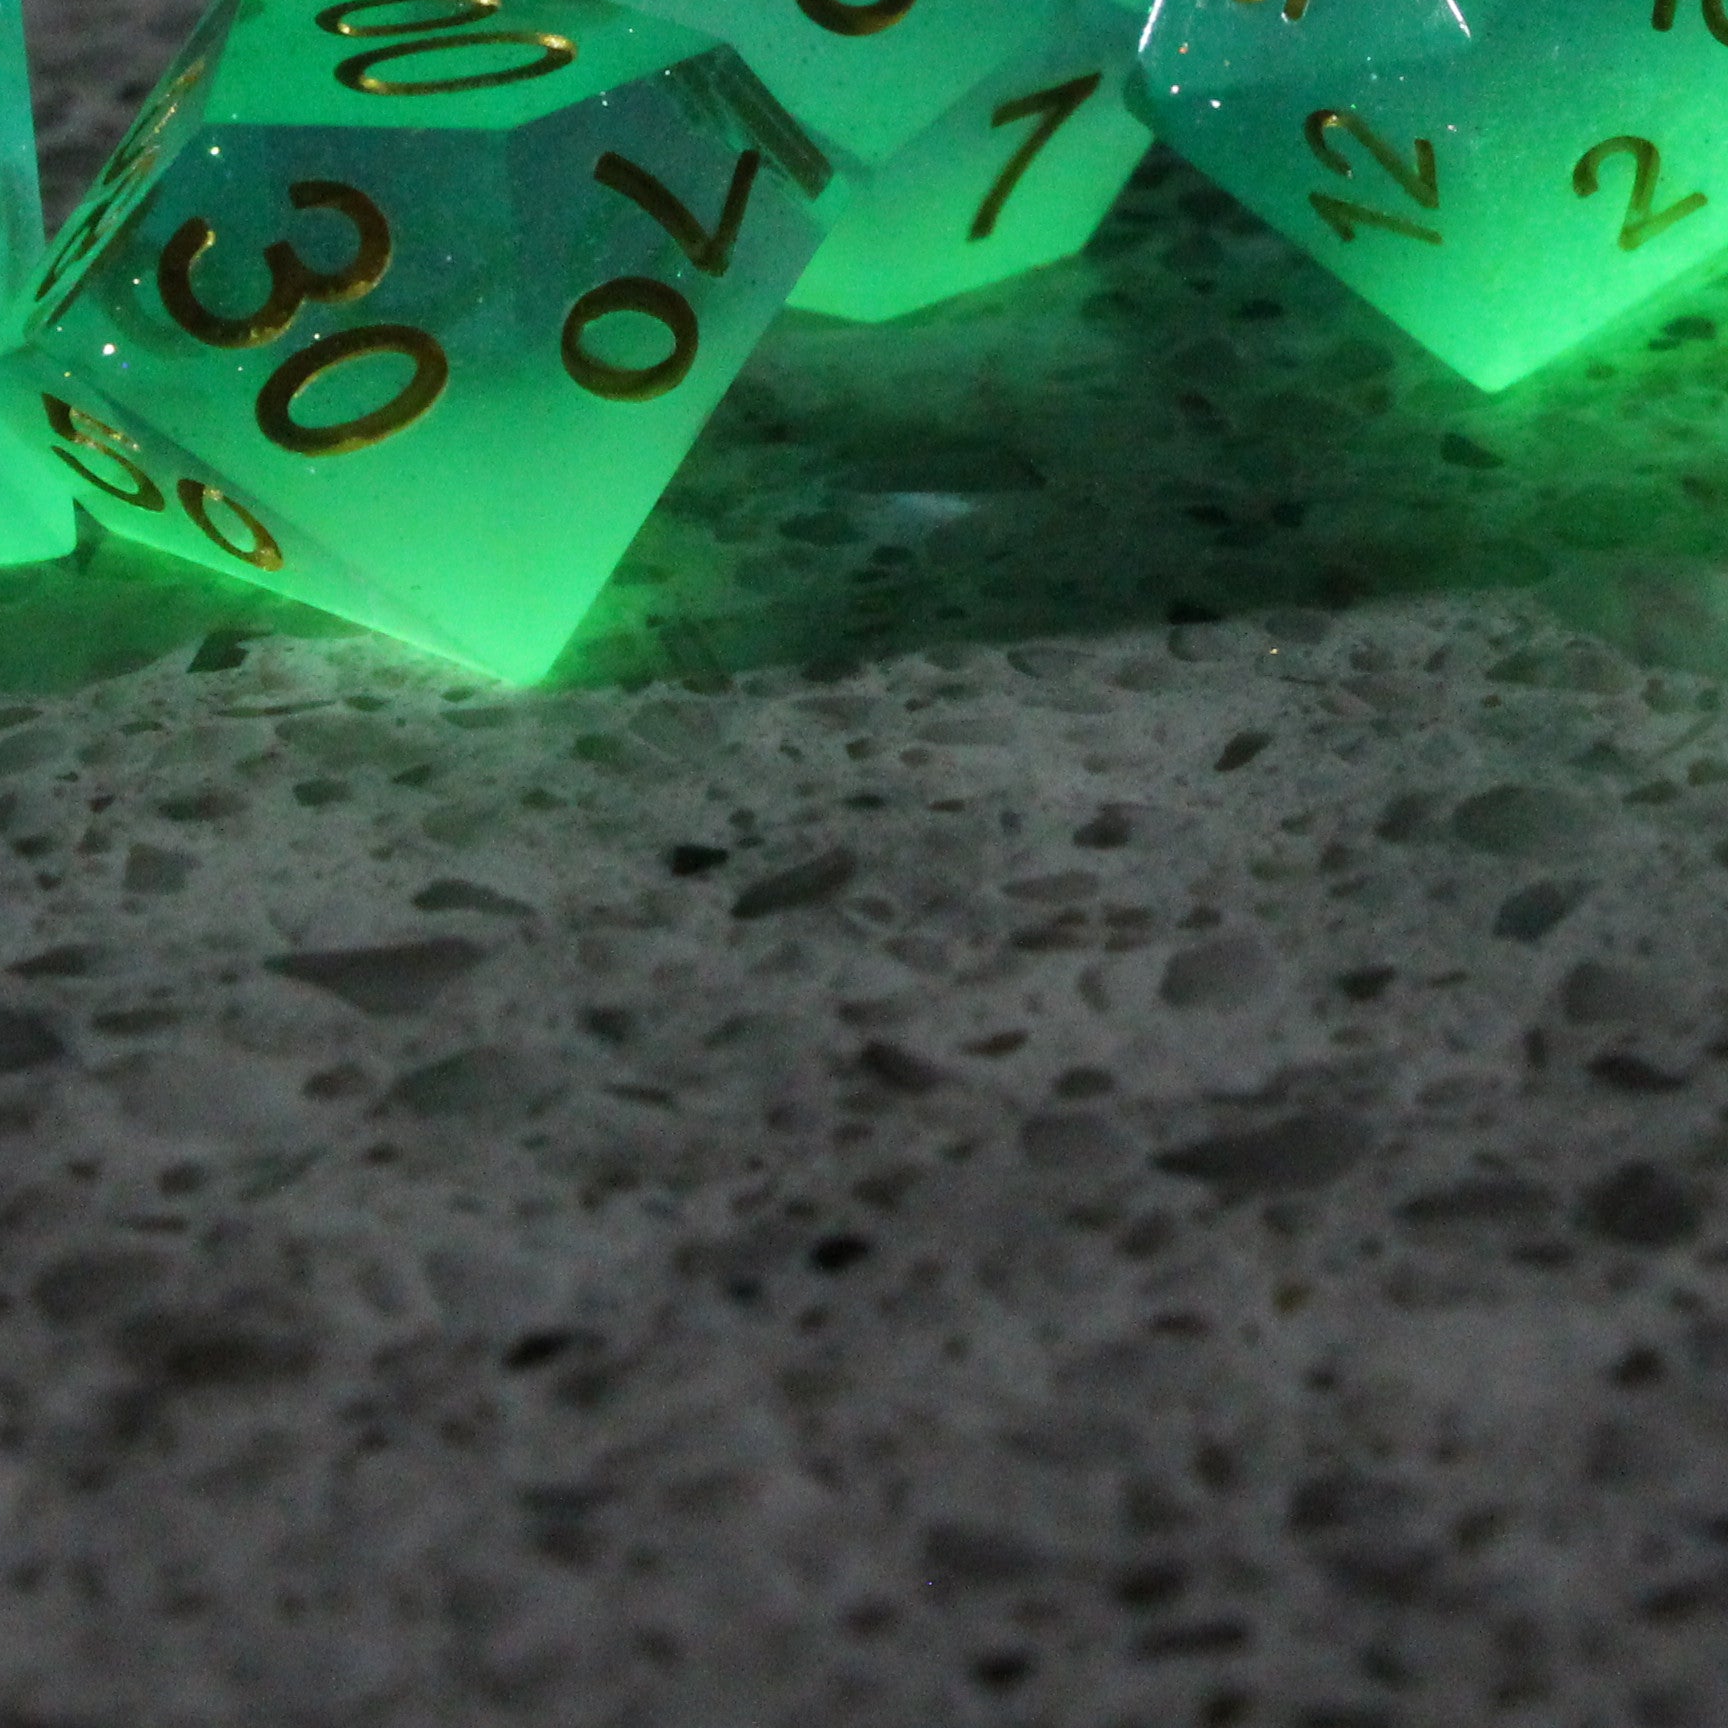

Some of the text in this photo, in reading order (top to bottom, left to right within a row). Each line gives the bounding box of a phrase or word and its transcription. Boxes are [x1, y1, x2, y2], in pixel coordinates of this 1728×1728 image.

[1303, 109, 1444, 246] 12
[1572, 134, 1709, 251] 2
[157, 180, 449, 458] 30
[560, 150, 761, 403] 70
